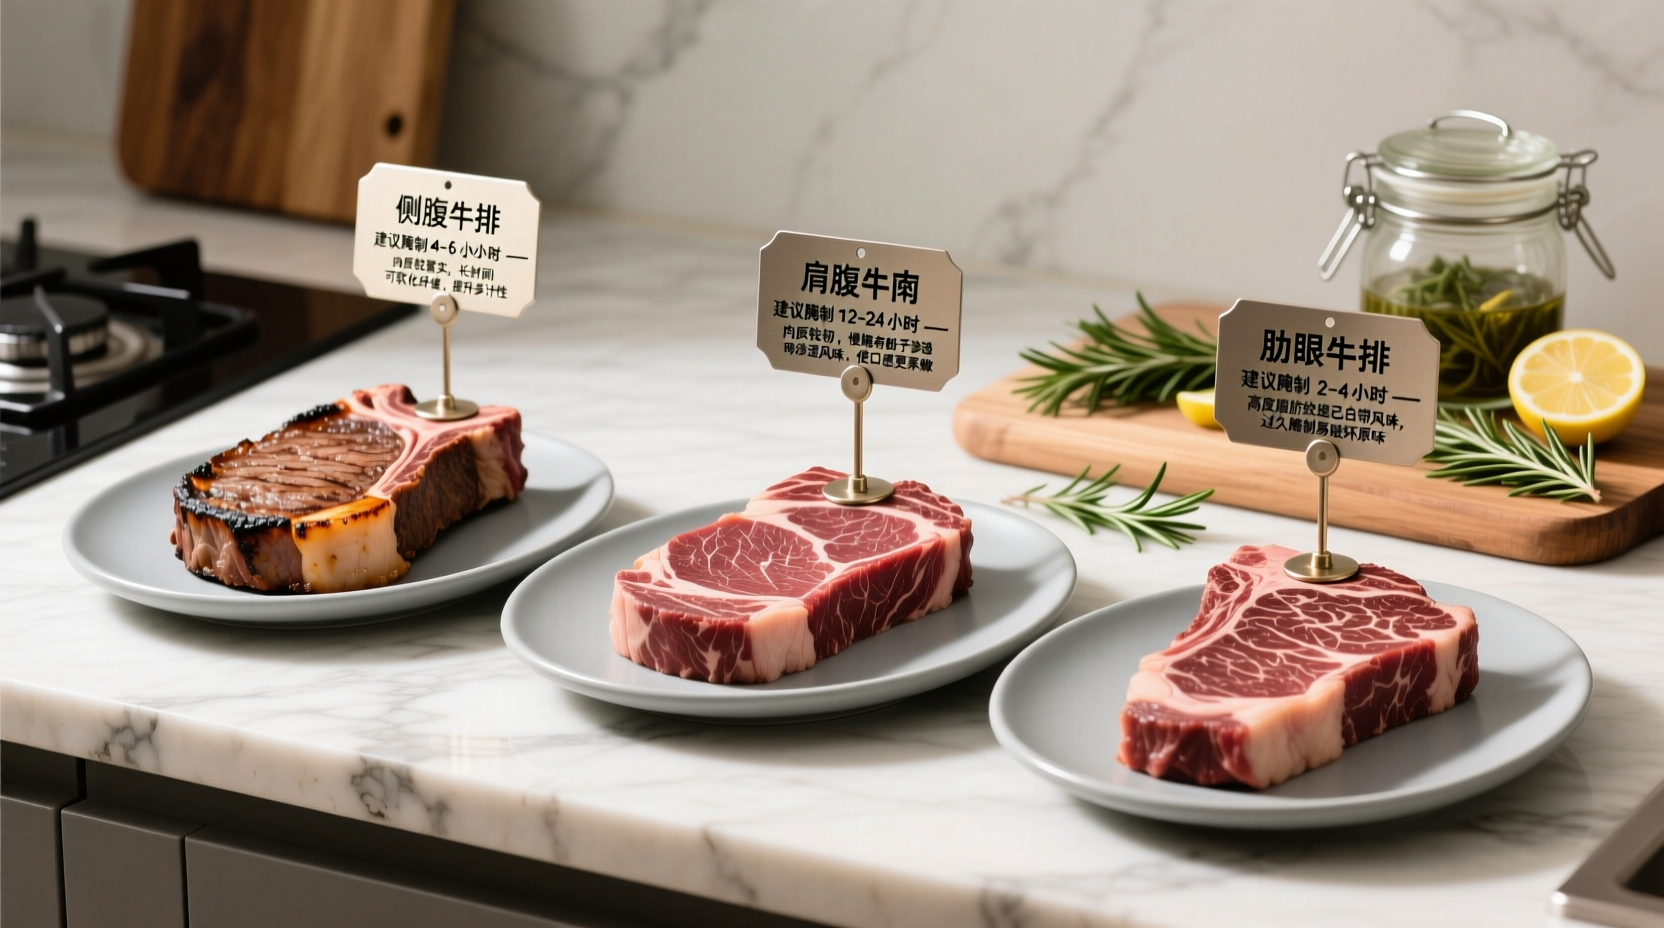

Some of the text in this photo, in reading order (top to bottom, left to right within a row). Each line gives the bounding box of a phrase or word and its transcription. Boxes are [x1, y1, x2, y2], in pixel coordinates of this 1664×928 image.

[396, 194, 501, 235] 侧腹牛排
[430, 239, 456, 255] 4-6
[839, 309, 884, 328] 12-24
[887, 313, 920, 333] 小时
[1260, 329, 1390, 374] 肋眼牛排
[1317, 380, 1348, 399] 2-4
[1352, 383, 1388, 404] 小时
